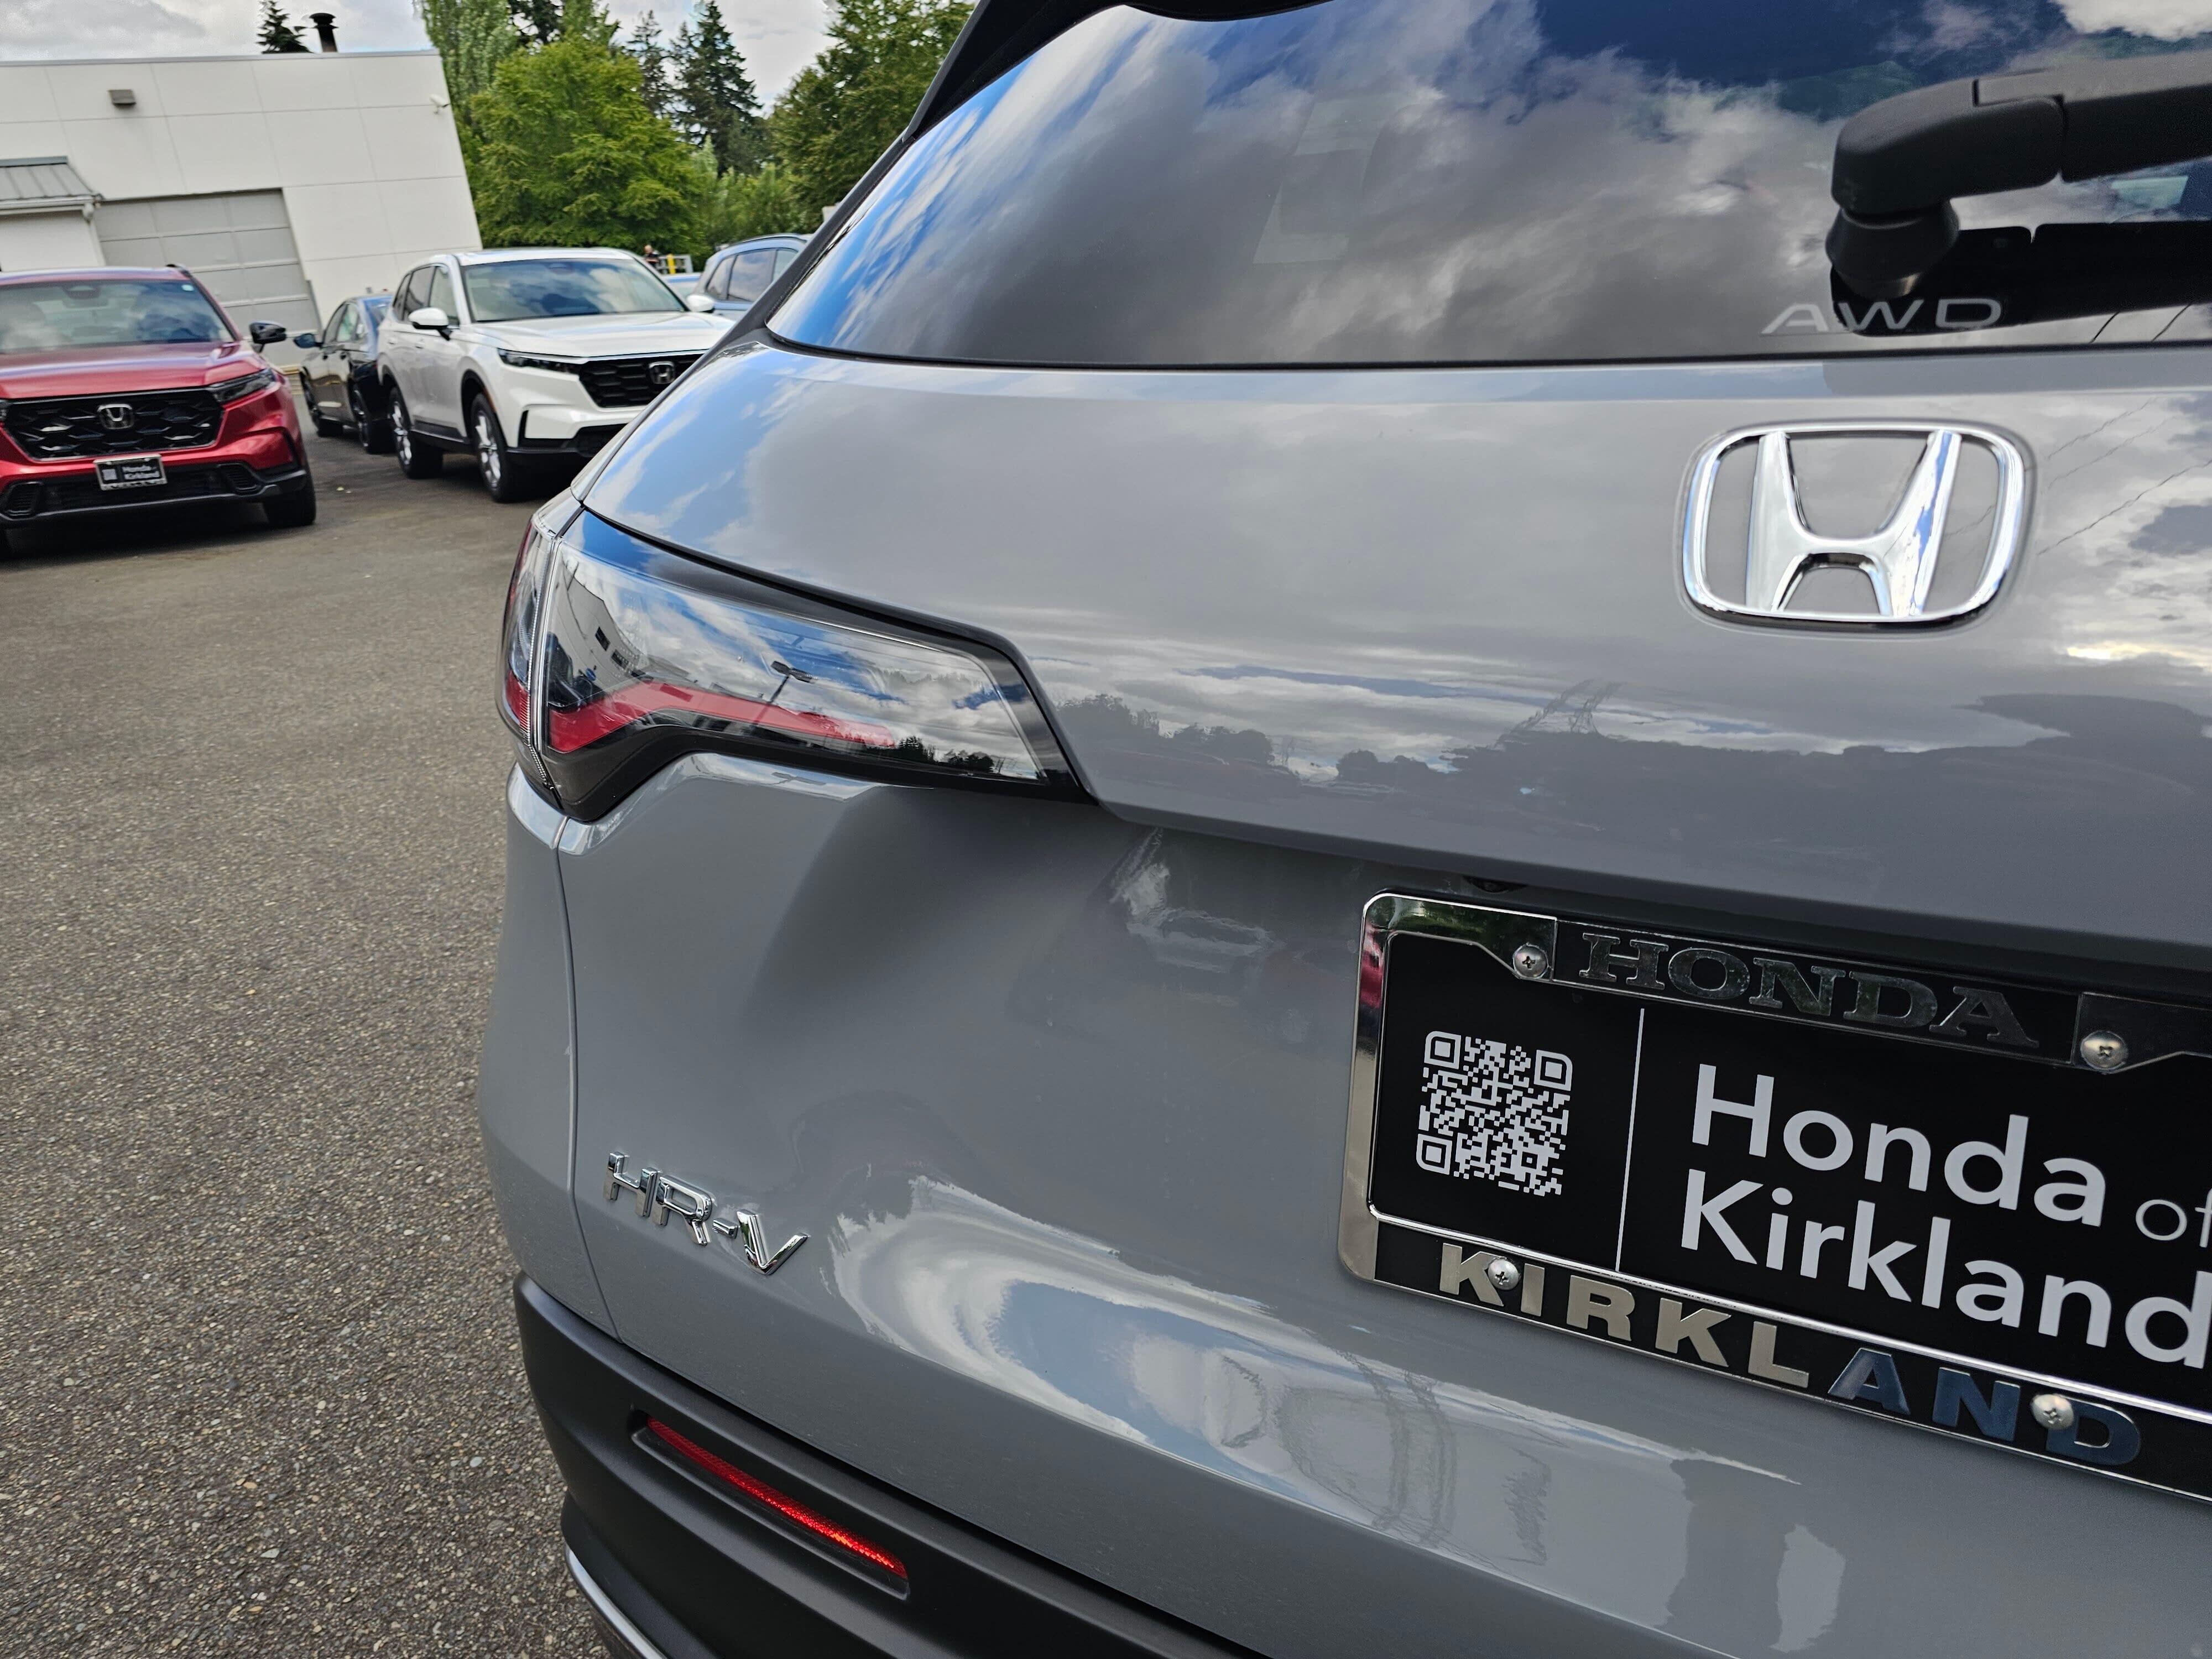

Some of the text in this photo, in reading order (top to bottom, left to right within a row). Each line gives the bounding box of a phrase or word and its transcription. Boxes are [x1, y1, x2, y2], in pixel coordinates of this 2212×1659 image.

[1760, 298, 2002, 334] AWD
[1579, 932, 2039, 1048] HONDA
[603, 1151, 810, 1275] HR-V
[1692, 1063, 2212, 1248] Honda of
[1681, 1168, 2212, 1369] Kirkland
[1439, 1243, 2141, 1465] KIRKLAND
